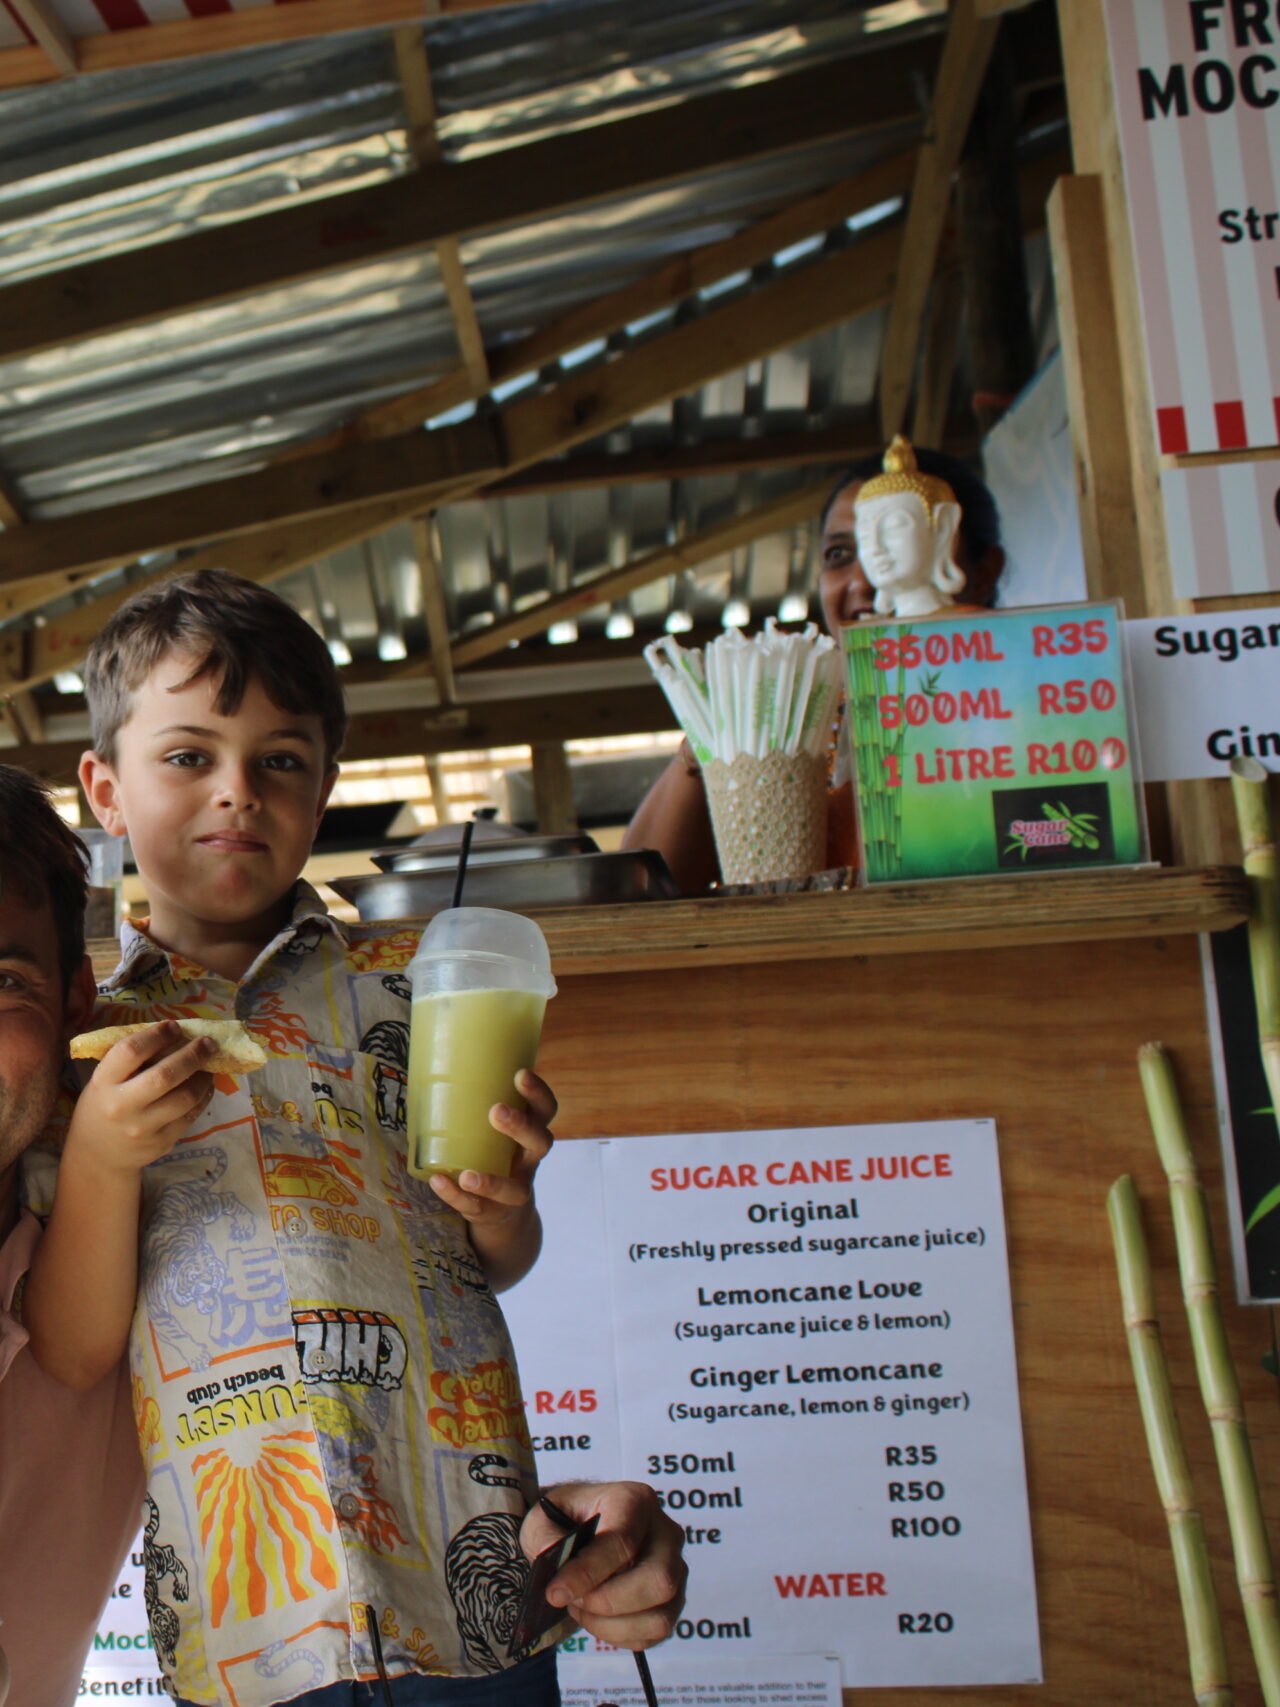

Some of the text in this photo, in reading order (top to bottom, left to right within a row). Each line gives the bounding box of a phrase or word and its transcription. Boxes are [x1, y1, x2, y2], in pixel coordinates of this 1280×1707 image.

[1189, 0, 1280, 52] FR
[1137, 55, 1280, 121] MOC
[1218, 207, 1280, 243] Str
[873, 620, 1109, 671] 350ML R35
[877, 687, 1013, 729] 500ML
[1038, 678, 1117, 716] R50
[1207, 725, 1280, 762] Gin
[882, 755, 902, 787] 1
[1027, 736, 1128, 776] R100
[1010, 819, 1071, 836] Sugar
[1022, 832, 1072, 848] Cane
[649, 1153, 952, 1192] SUGAR CANE JUICE
[310, 1206, 383, 1244] SHOP
[747, 1199, 859, 1228] Original
[628, 1226, 987, 1263] (Freshly pressed sugarcane juice)
[697, 1278, 923, 1306] Lemoncane Love
[675, 1310, 951, 1341] (Sugarcane juice & lemon)
[186, 1364, 284, 1404] beach club
[690, 1359, 943, 1391] Ginger Lemoncane
[534, 1390, 598, 1414] R45
[668, 1391, 971, 1423] (Sugarcane, lemon & ginger)
[530, 1433, 591, 1452] cane
[648, 1445, 937, 1475] 350ml R35
[888, 1481, 944, 1502] R50
[685, 1515, 961, 1545] tre R100
[775, 1572, 887, 1598] WATER
[676, 1612, 953, 1639] 00ml R20
